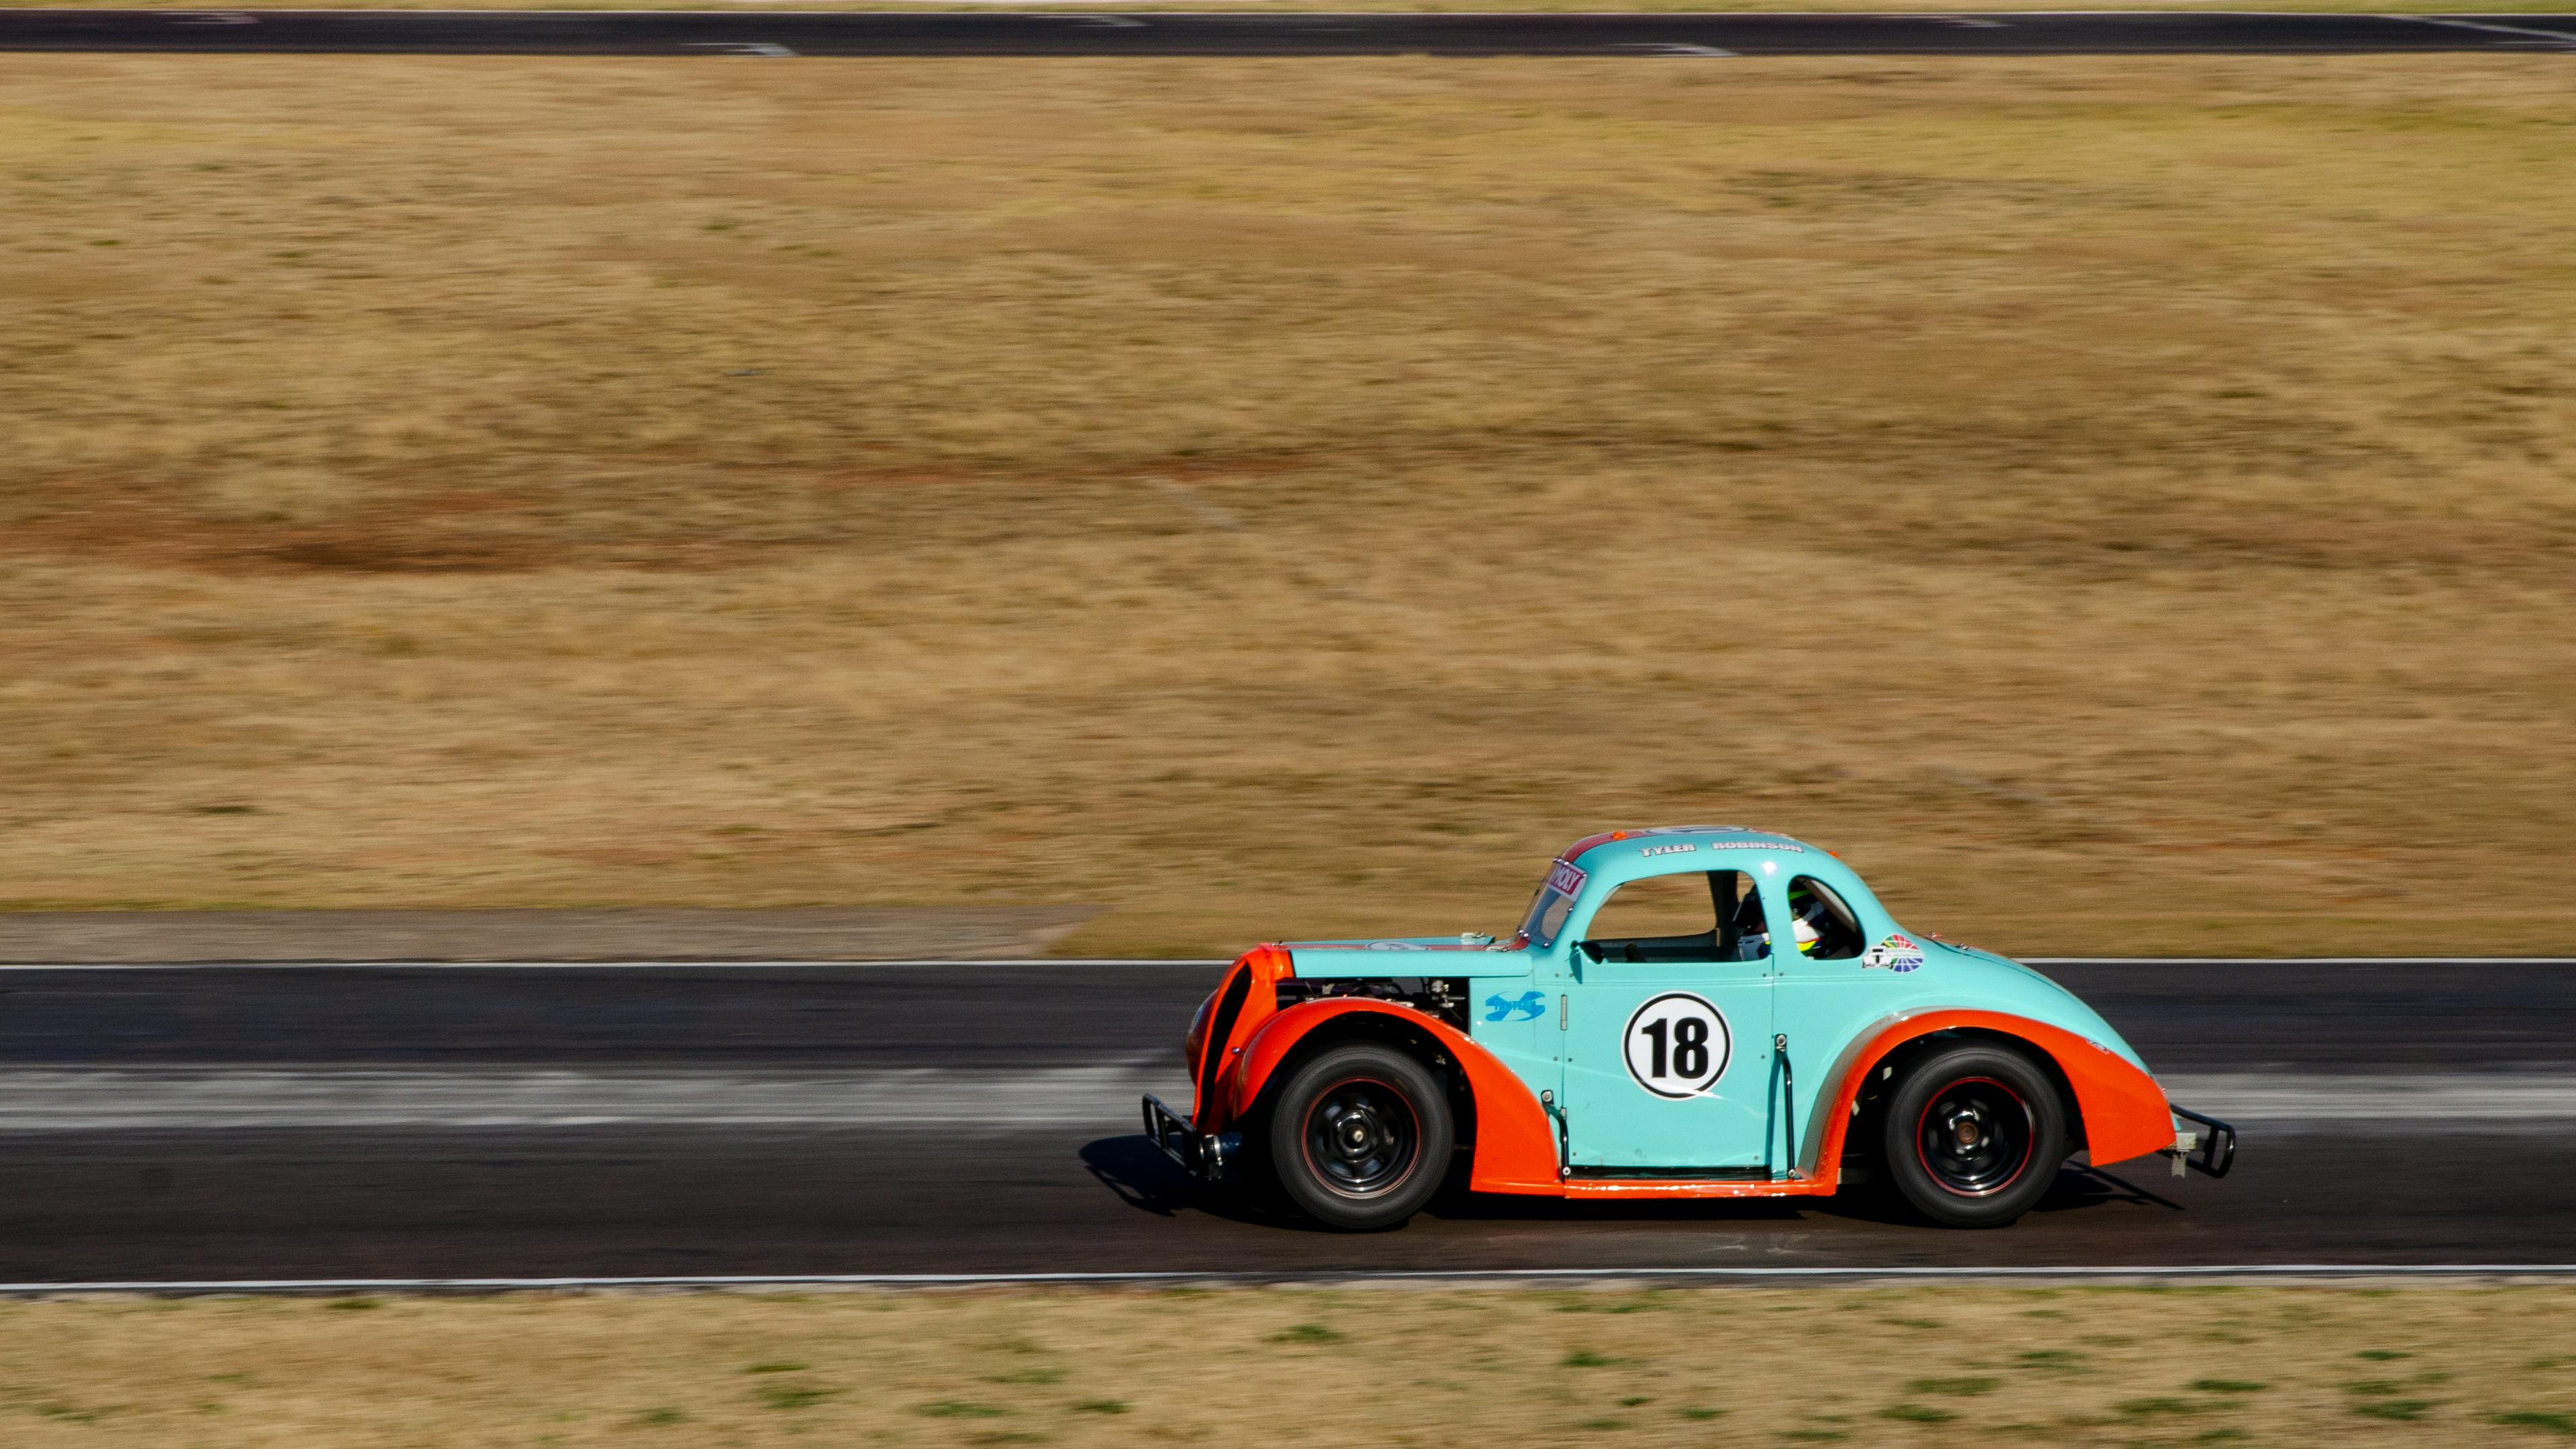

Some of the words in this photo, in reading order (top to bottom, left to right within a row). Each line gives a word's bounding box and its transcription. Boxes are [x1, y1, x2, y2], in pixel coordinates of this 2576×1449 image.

[1640, 843, 1697, 857] TYLER
[1711, 842, 1804, 853] ROBINSON
[1551, 866, 1580, 891] MOLY
[1641, 1017, 1709, 1079] 18
